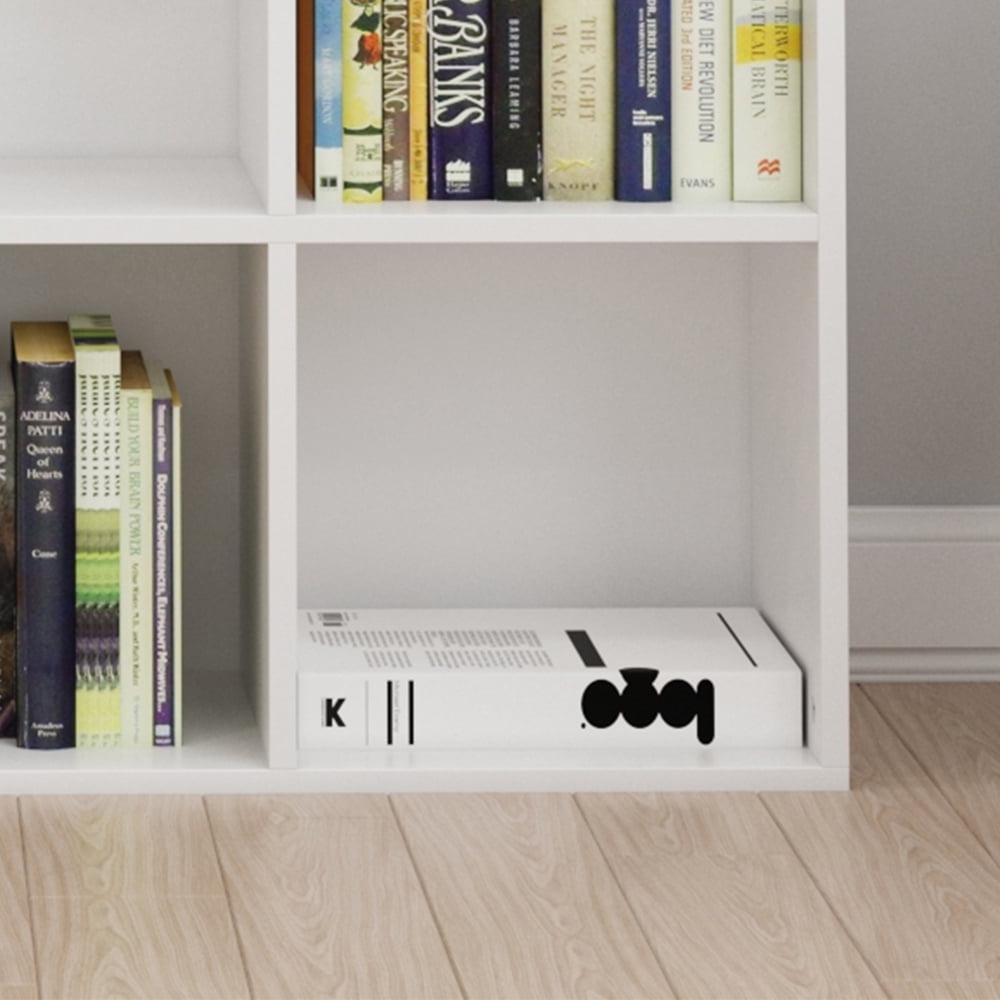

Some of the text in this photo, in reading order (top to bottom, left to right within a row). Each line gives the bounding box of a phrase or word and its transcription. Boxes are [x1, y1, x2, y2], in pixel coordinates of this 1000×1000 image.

[508, 18, 520, 71] BARBARA
[646, 18, 657, 49] JERRI
[681, 27, 693, 45] 3rd
[698, 28, 714, 56] DIET
[383, 29, 408, 113] SPEAKING
[427, 4, 487, 128] BANKS
[551, 23, 568, 119] MANAGER
[578, 16, 597, 123] THE NIGHT
[646, 50, 657, 98] NIELSEN
[681, 48, 693, 91] EDITION
[508, 77, 520, 130] LEAMING
[698, 60, 714, 144] REVOLUTION
[751, 67, 767, 119] BRAIN
[679, 178, 716, 188] EVANS
[19, 410, 71, 422] ADELINA
[27, 425, 63, 436] PATTI
[26, 443, 63, 456] Queen
[36, 457, 50, 467] of
[127, 434, 140, 467] YOUR
[26, 469, 63, 480] Hearts
[128, 471, 141, 510] BRAIN
[155, 473, 168, 521] DOLPHIN
[128, 513, 141, 557] POWER
[156, 596, 168, 650] ELEPHANT
[324, 697, 347, 728] K
